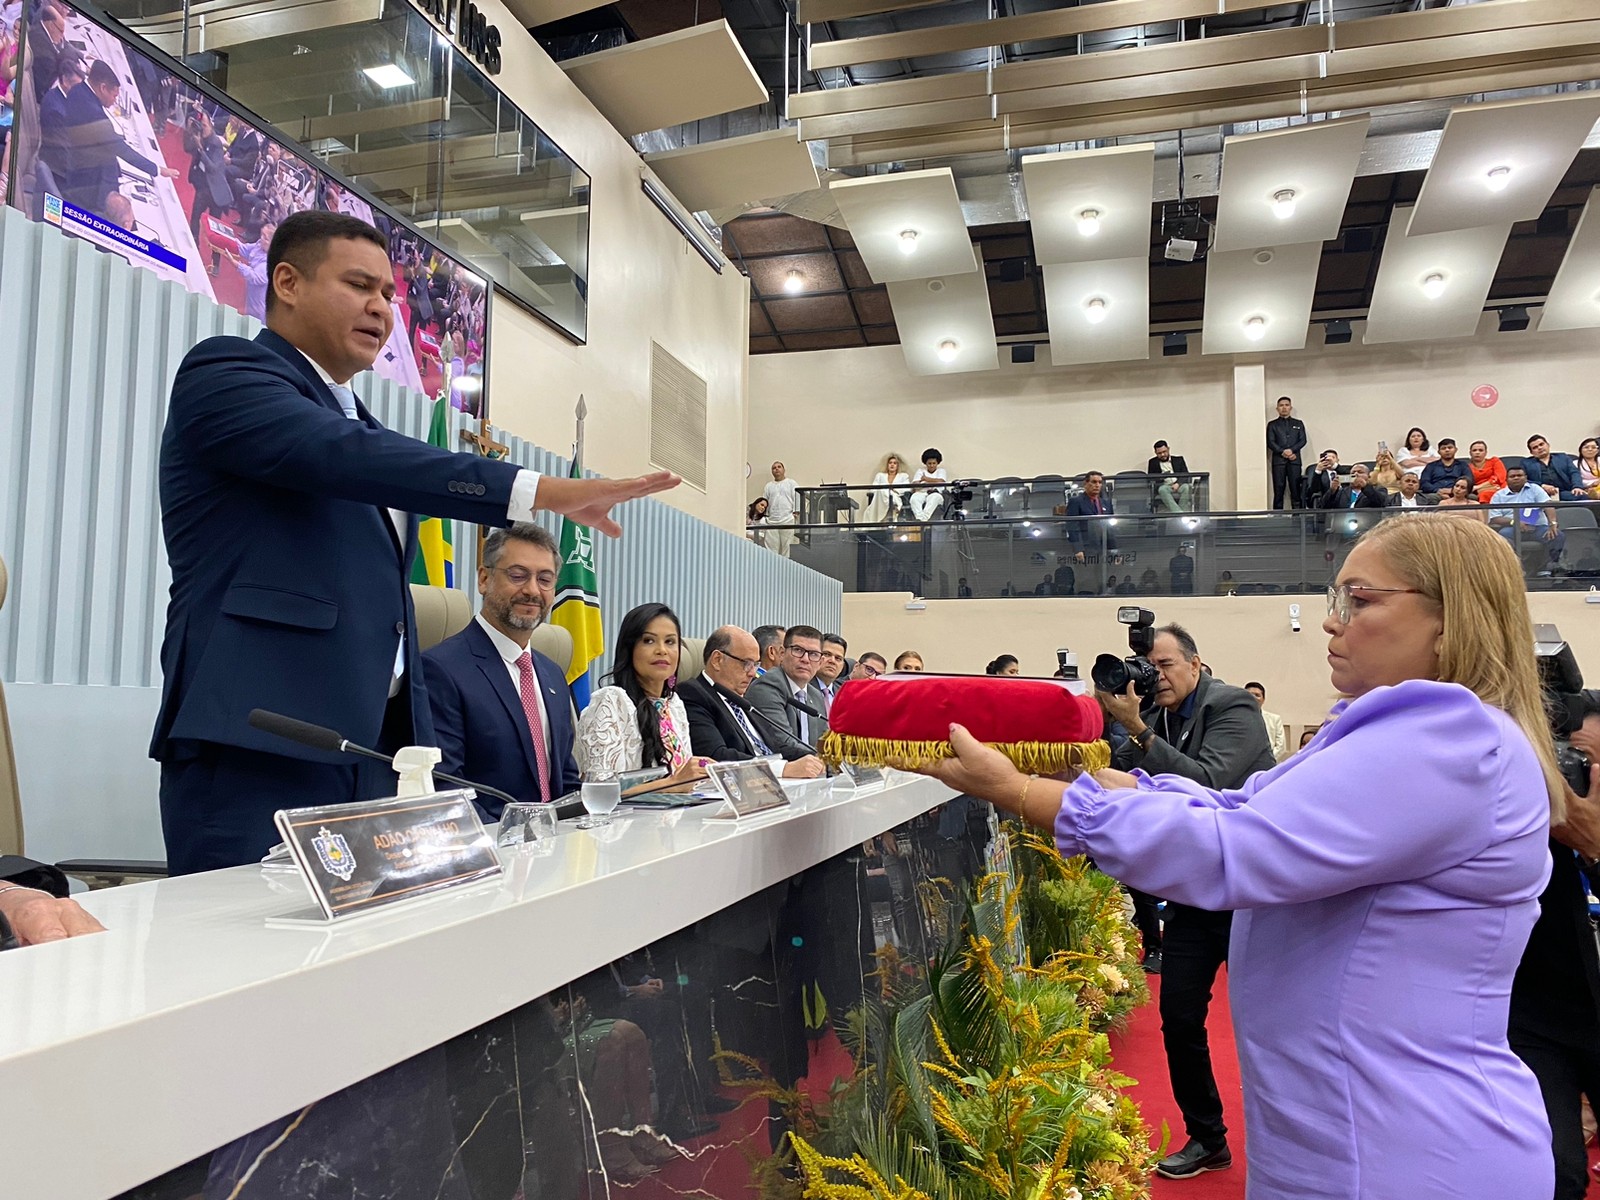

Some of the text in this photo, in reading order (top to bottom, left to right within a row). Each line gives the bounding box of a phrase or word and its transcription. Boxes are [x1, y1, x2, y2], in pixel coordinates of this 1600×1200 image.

[64, 206, 93, 225] SESSÃO
[93, 220, 149, 252] EXTRAORDINÁRIA
[373, 829, 406, 849] ADÃO
